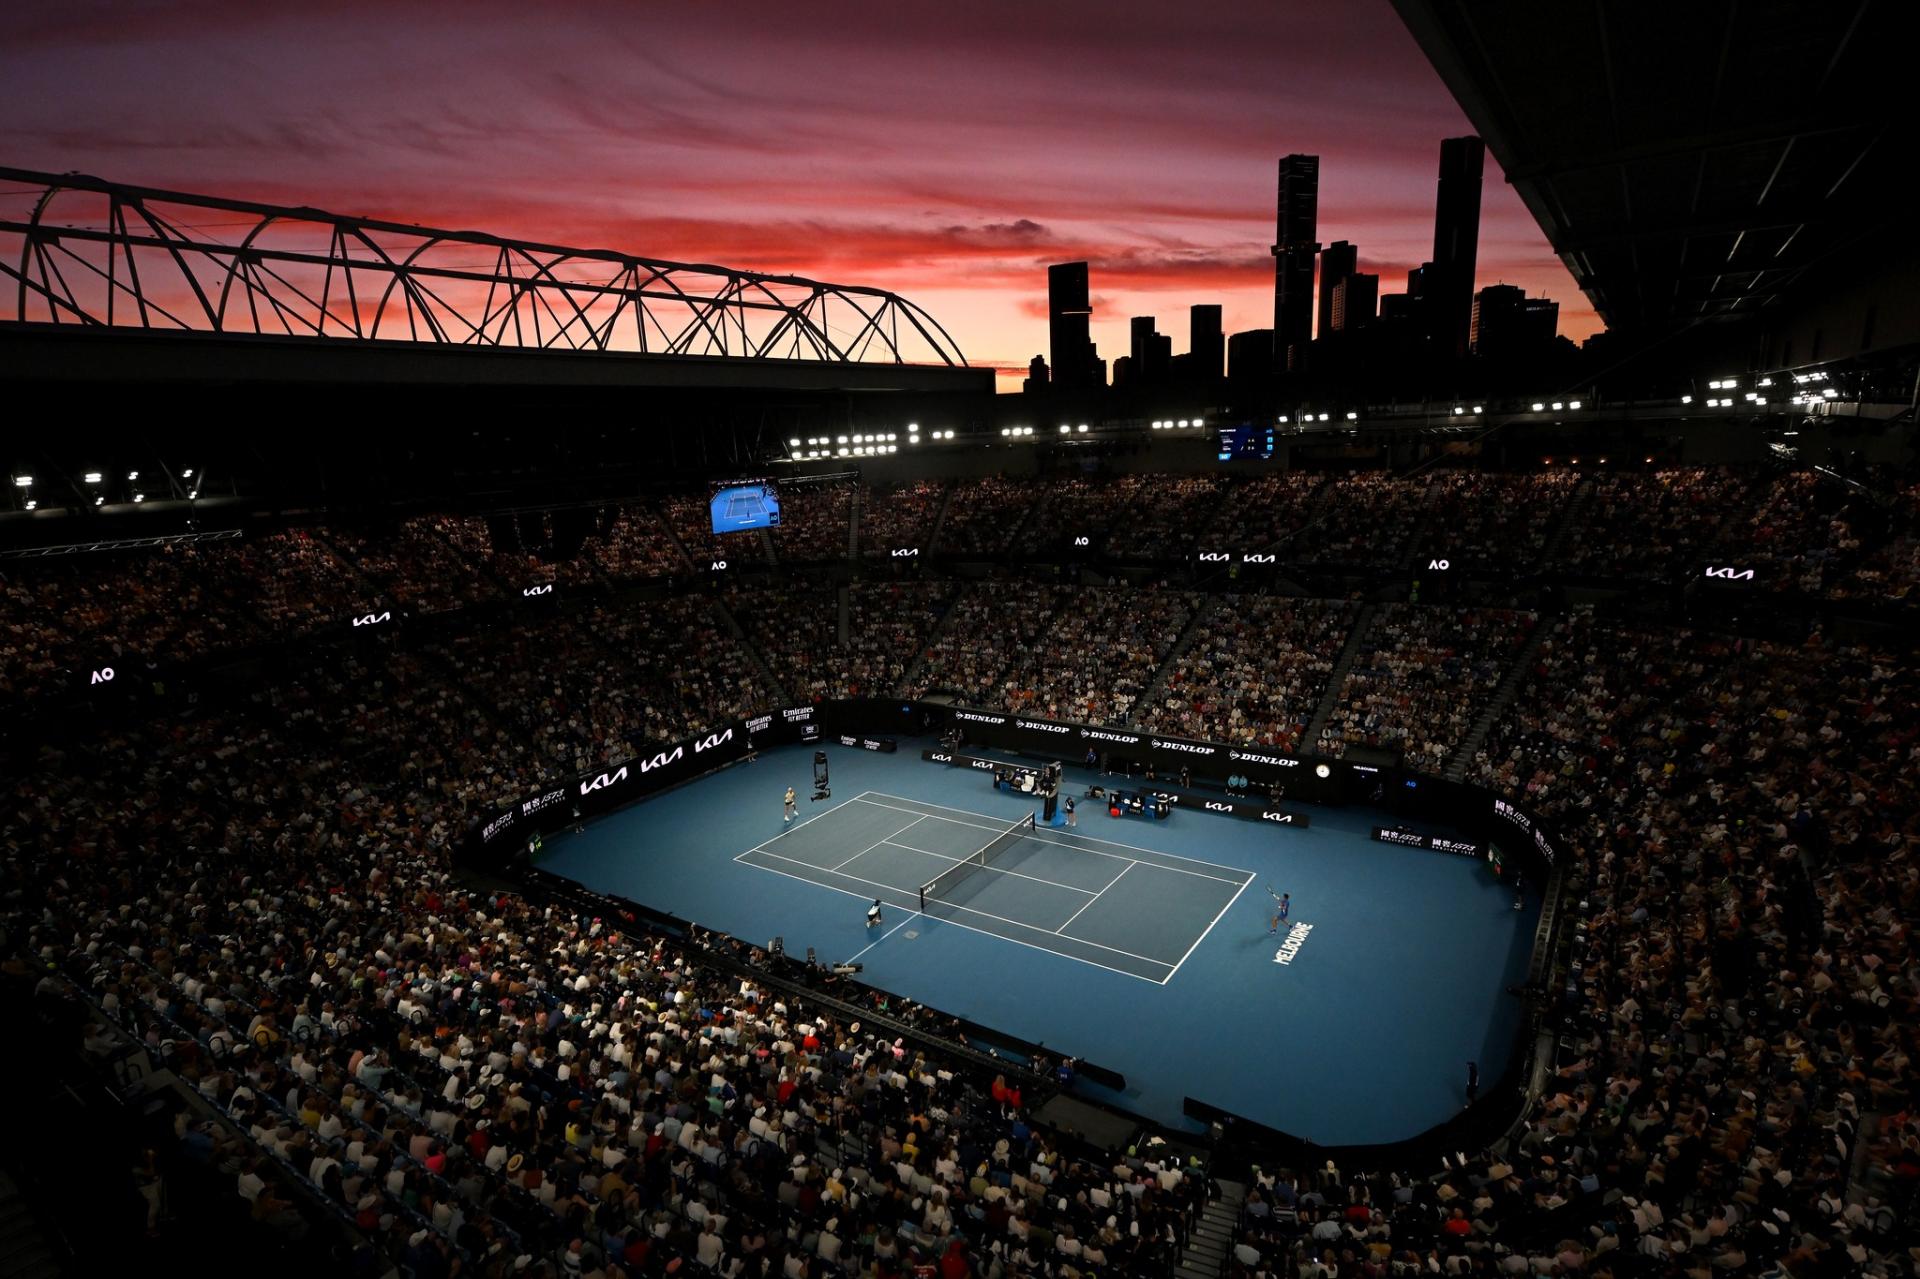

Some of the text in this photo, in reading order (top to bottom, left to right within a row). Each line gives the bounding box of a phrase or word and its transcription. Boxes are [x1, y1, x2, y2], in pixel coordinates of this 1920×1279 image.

[782, 706, 814, 718] Emirates
[964, 713, 1005, 724] DUNLOP
[745, 715, 773, 729] Emirates
[1025, 721, 1070, 734] DUNLOP
[695, 728, 733, 753] KIA
[1090, 731, 1139, 744] DUNLOP
[1161, 741, 1215, 755] DUNLOP
[641, 746, 684, 773] KIA
[1241, 753, 1299, 767] DUNLOP
[580, 766, 628, 795] KIA
[1272, 921, 1314, 966] MELBOURNE
